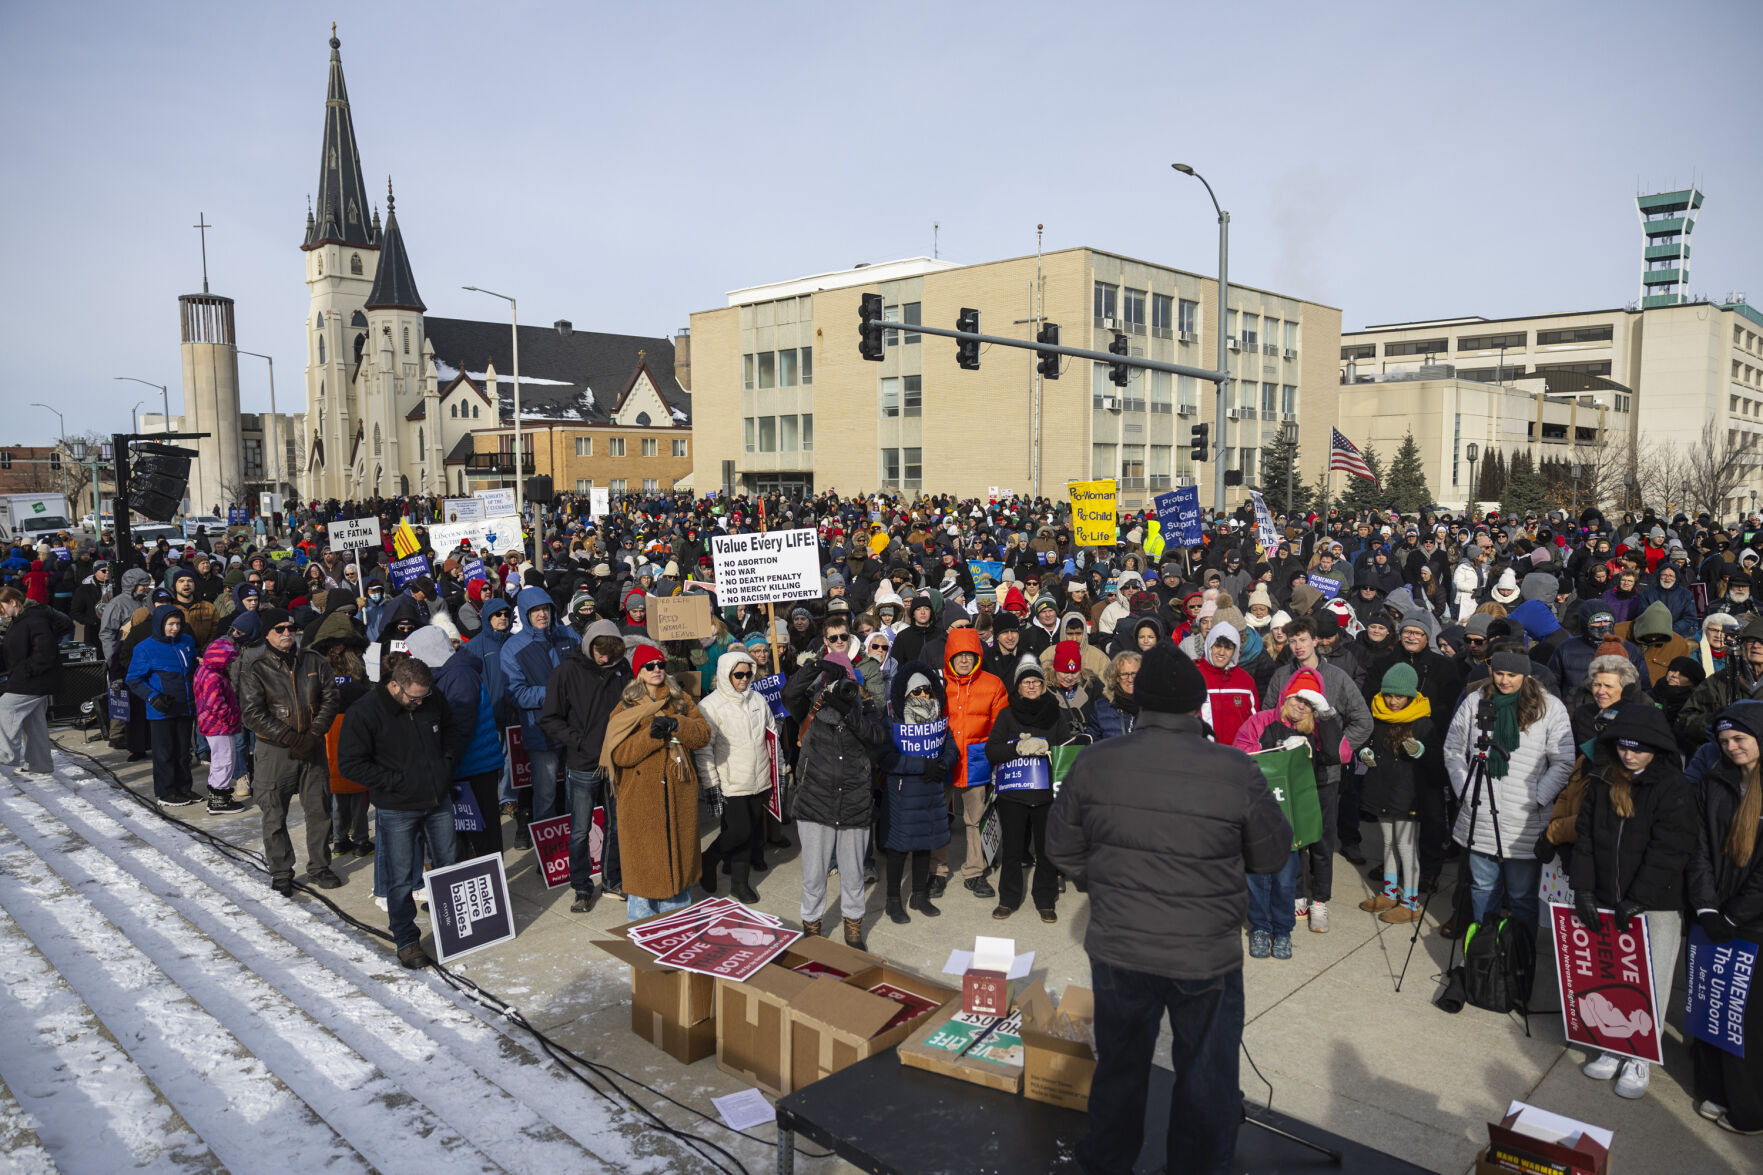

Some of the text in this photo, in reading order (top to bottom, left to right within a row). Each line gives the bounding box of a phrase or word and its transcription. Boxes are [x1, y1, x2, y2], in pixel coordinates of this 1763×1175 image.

[1162, 493, 1192, 506] Protect
[1159, 505, 1180, 517] Every
[1179, 510, 1197, 520] Child
[349, 520, 359, 528] GX
[334, 528, 372, 539] ME FATIMA
[434, 530, 461, 539] LINCOLN
[343, 539, 369, 550] OMAHA
[716, 532, 815, 554] Value Every LIFE:
[390, 556, 423, 570] REMEMBER
[738, 556, 778, 566] ABORTION
[404, 565, 425, 575] Unborn
[970, 565, 981, 573] No
[739, 576, 764, 584] DEATH
[767, 573, 802, 582] PENALTY
[1311, 574, 1339, 586] REMEMBER
[740, 585, 766, 593] MERCY
[769, 582, 801, 591] KILLING
[1319, 583, 1336, 592] Unborn
[741, 594, 770, 602] RACISM
[782, 589, 818, 599] POVERTY
[901, 740, 920, 752] The
[1006, 758, 1040, 768] Unborn
[537, 823, 571, 841] LOVE
[540, 840, 570, 856] THE
[546, 856, 570, 874] BOT
[467, 880, 480, 917] more
[479, 877, 493, 914] make
[452, 884, 467, 936] babies.
[650, 931, 696, 950] LOVE
[1559, 931, 1568, 943] for
[671, 942, 712, 964] LOVE
[1561, 944, 1568, 952] by
[1618, 923, 1640, 984] OVE
[693, 947, 732, 968] THEM
[714, 950, 754, 974] BOTH
[1564, 954, 1573, 988] Nebraska
[1686, 944, 1697, 1014] liferunners.org
[1698, 966, 1707, 1000] Jer 1:5
[1708, 946, 1732, 1035] The Unborn
[1567, 988, 1576, 1007] Right
[1727, 950, 1755, 1046] REMEMBER
[1571, 1008, 1576, 1016] to
[1496, 1151, 1519, 1165] HAND
